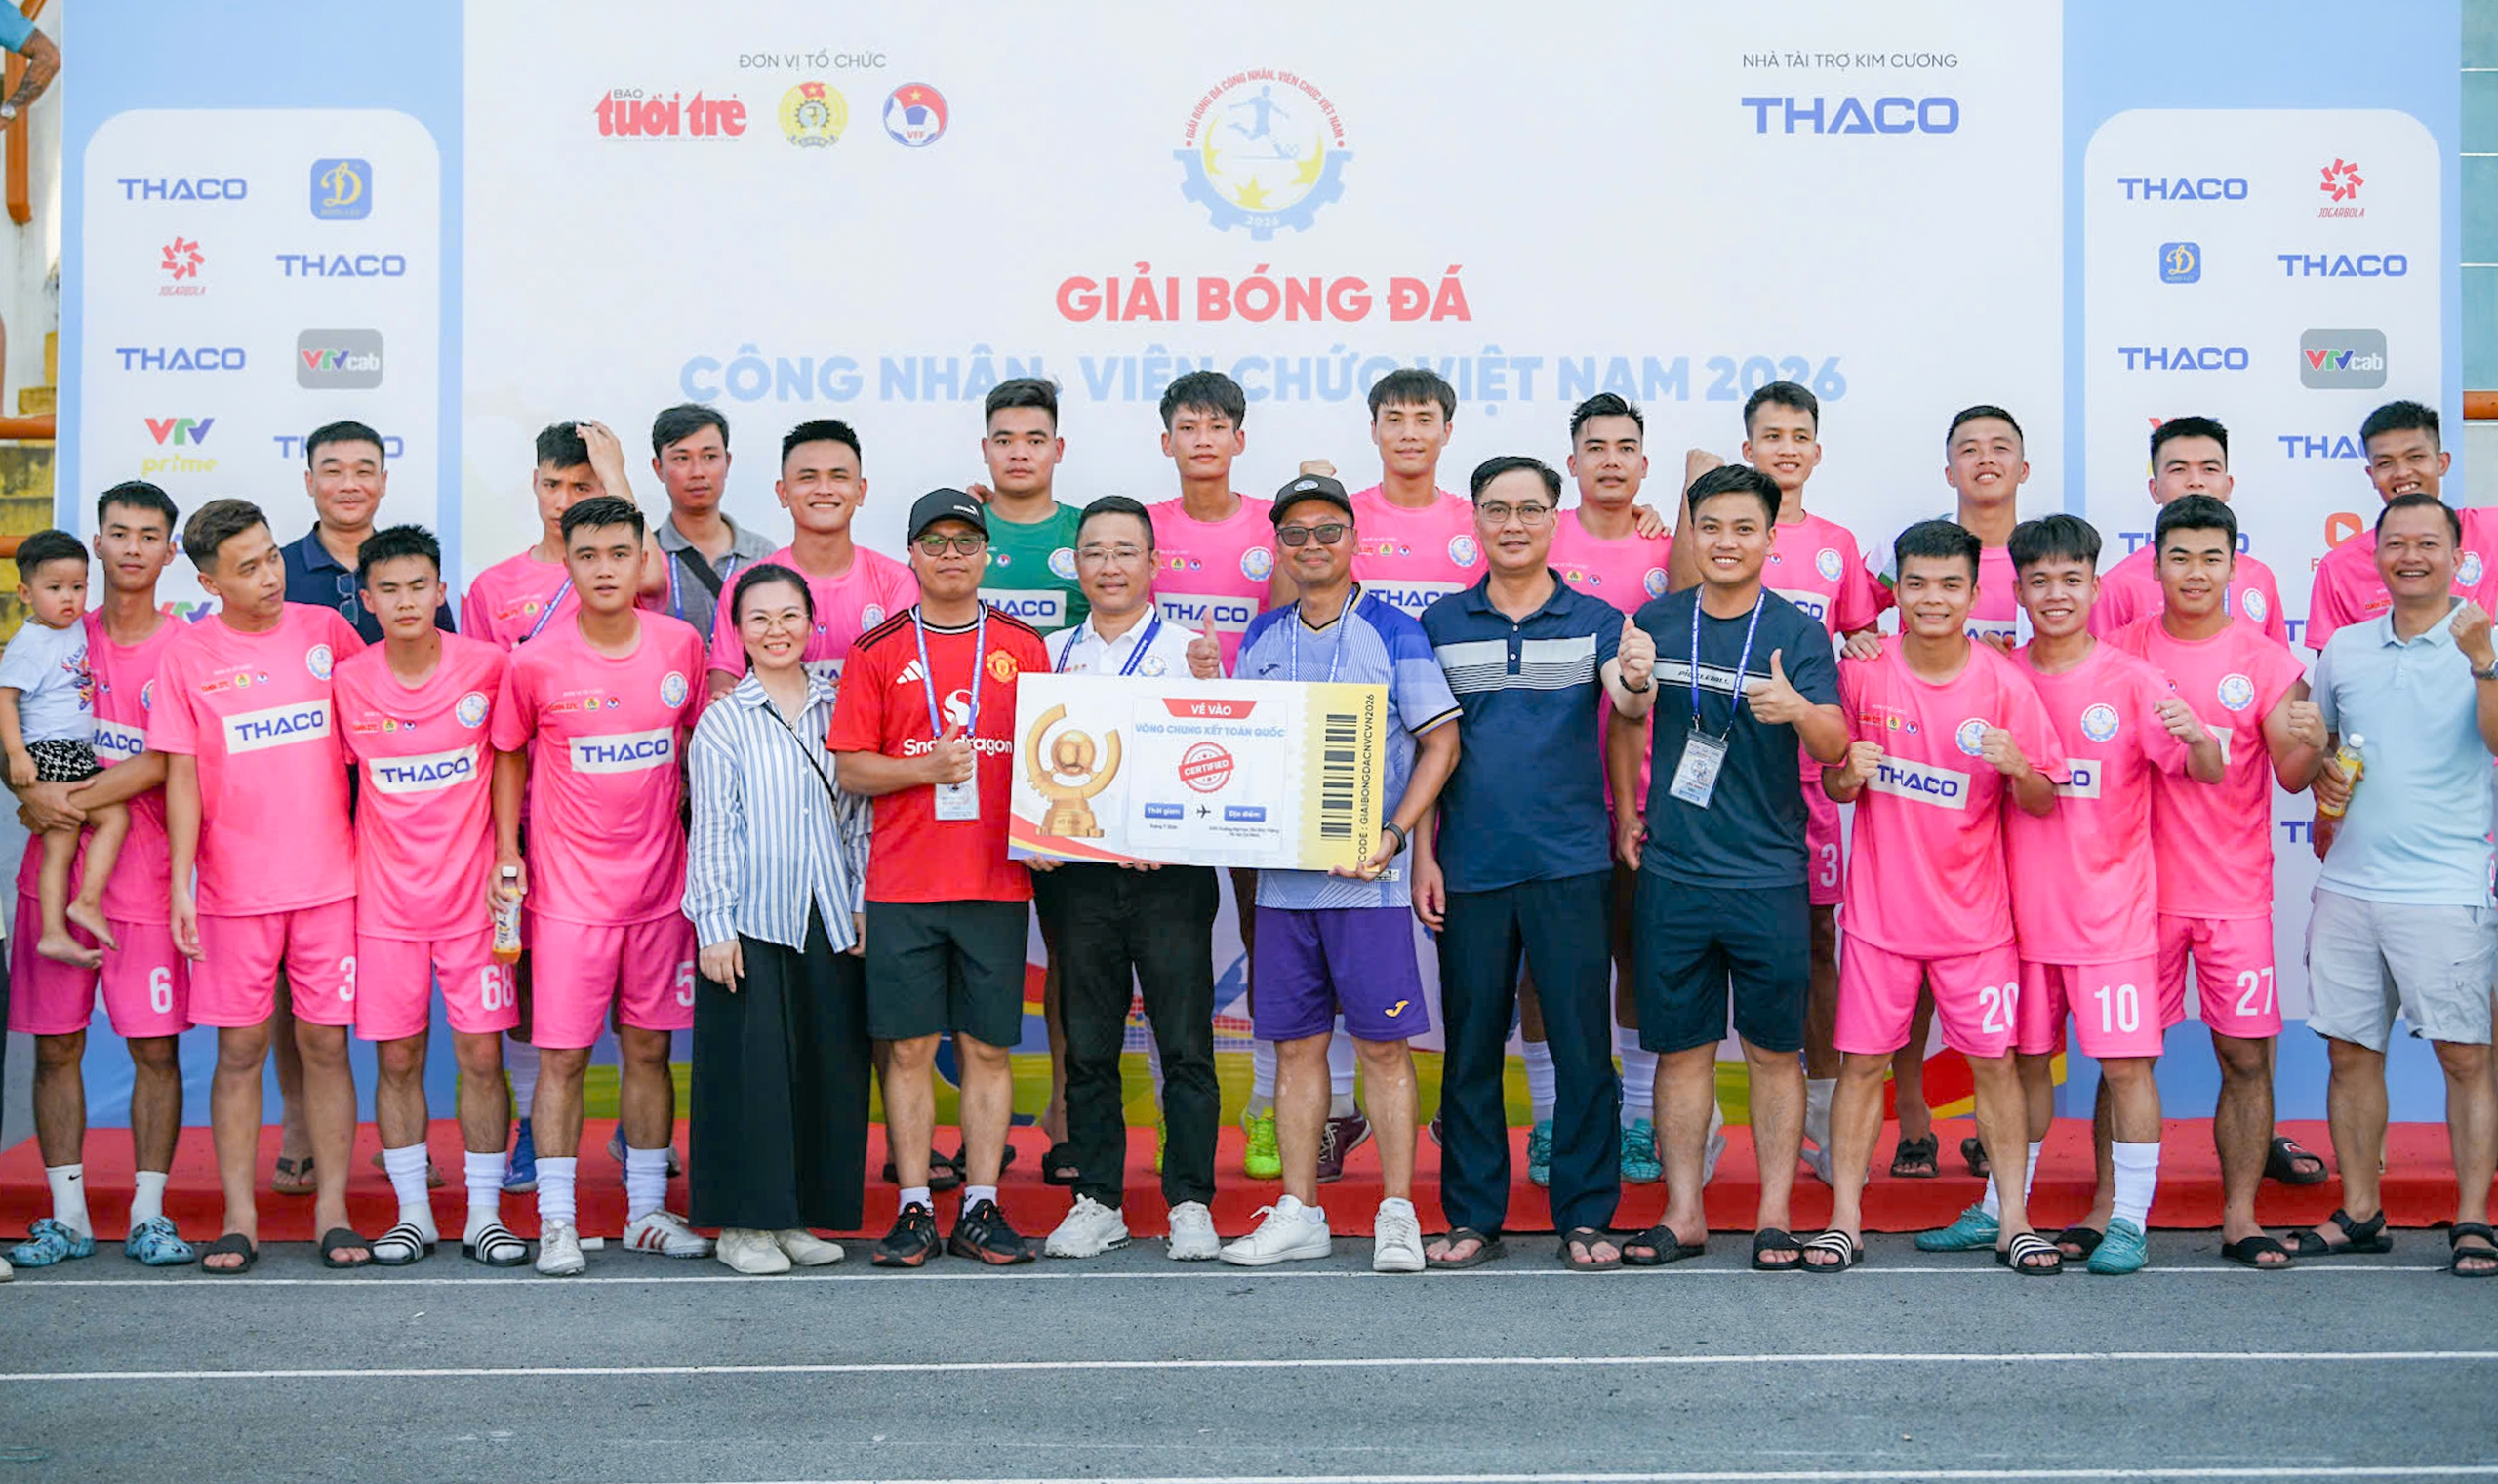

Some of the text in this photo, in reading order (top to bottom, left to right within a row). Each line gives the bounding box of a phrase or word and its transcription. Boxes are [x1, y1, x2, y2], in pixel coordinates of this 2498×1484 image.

[739, 49, 887, 71] ĐƠN VỊ TỔ CHỨC
[1743, 51, 1959, 72] NHÀ TÀI TRỢ KIM CƯƠNG
[1329, 115, 1345, 139] NAM
[1741, 97, 1960, 135] THACO
[117, 178, 248, 201] THACO
[2117, 178, 2248, 200] THACO
[275, 255, 406, 277] THACO
[2277, 254, 2408, 277] THACO
[1056, 261, 1472, 323] GIẢI BÓNG ĐÁ
[115, 347, 246, 371] THACO
[2117, 347, 2249, 371] THACO
[679, 343, 865, 403] CÔNG
[1557, 355, 1690, 402] NAM
[144, 418, 215, 446] VTV
[141, 453, 219, 478] prime
[1190, 703, 1232, 716] VÉ VÀO
[235, 709, 324, 741] THACO
[1135, 723, 1285, 737] VÒNG CHUNG KẾT TOÀN QUỐC
[580, 738, 669, 763] THACO
[1359, 693, 1375, 825] GIAIBONGDACNVCVN2026
[380, 756, 471, 783] THACO
[1184, 759, 1229, 777] CERTIFIED
[1876, 764, 1958, 797] THACO
[1358, 834, 1368, 862] CODE
[1820, 843, 1838, 887] 3
[150, 966, 173, 1014] 6
[481, 964, 515, 1011] 68
[2236, 966, 2274, 1017] 27
[1979, 982, 2019, 1035] 20
[2095, 983, 2140, 1034] 10
